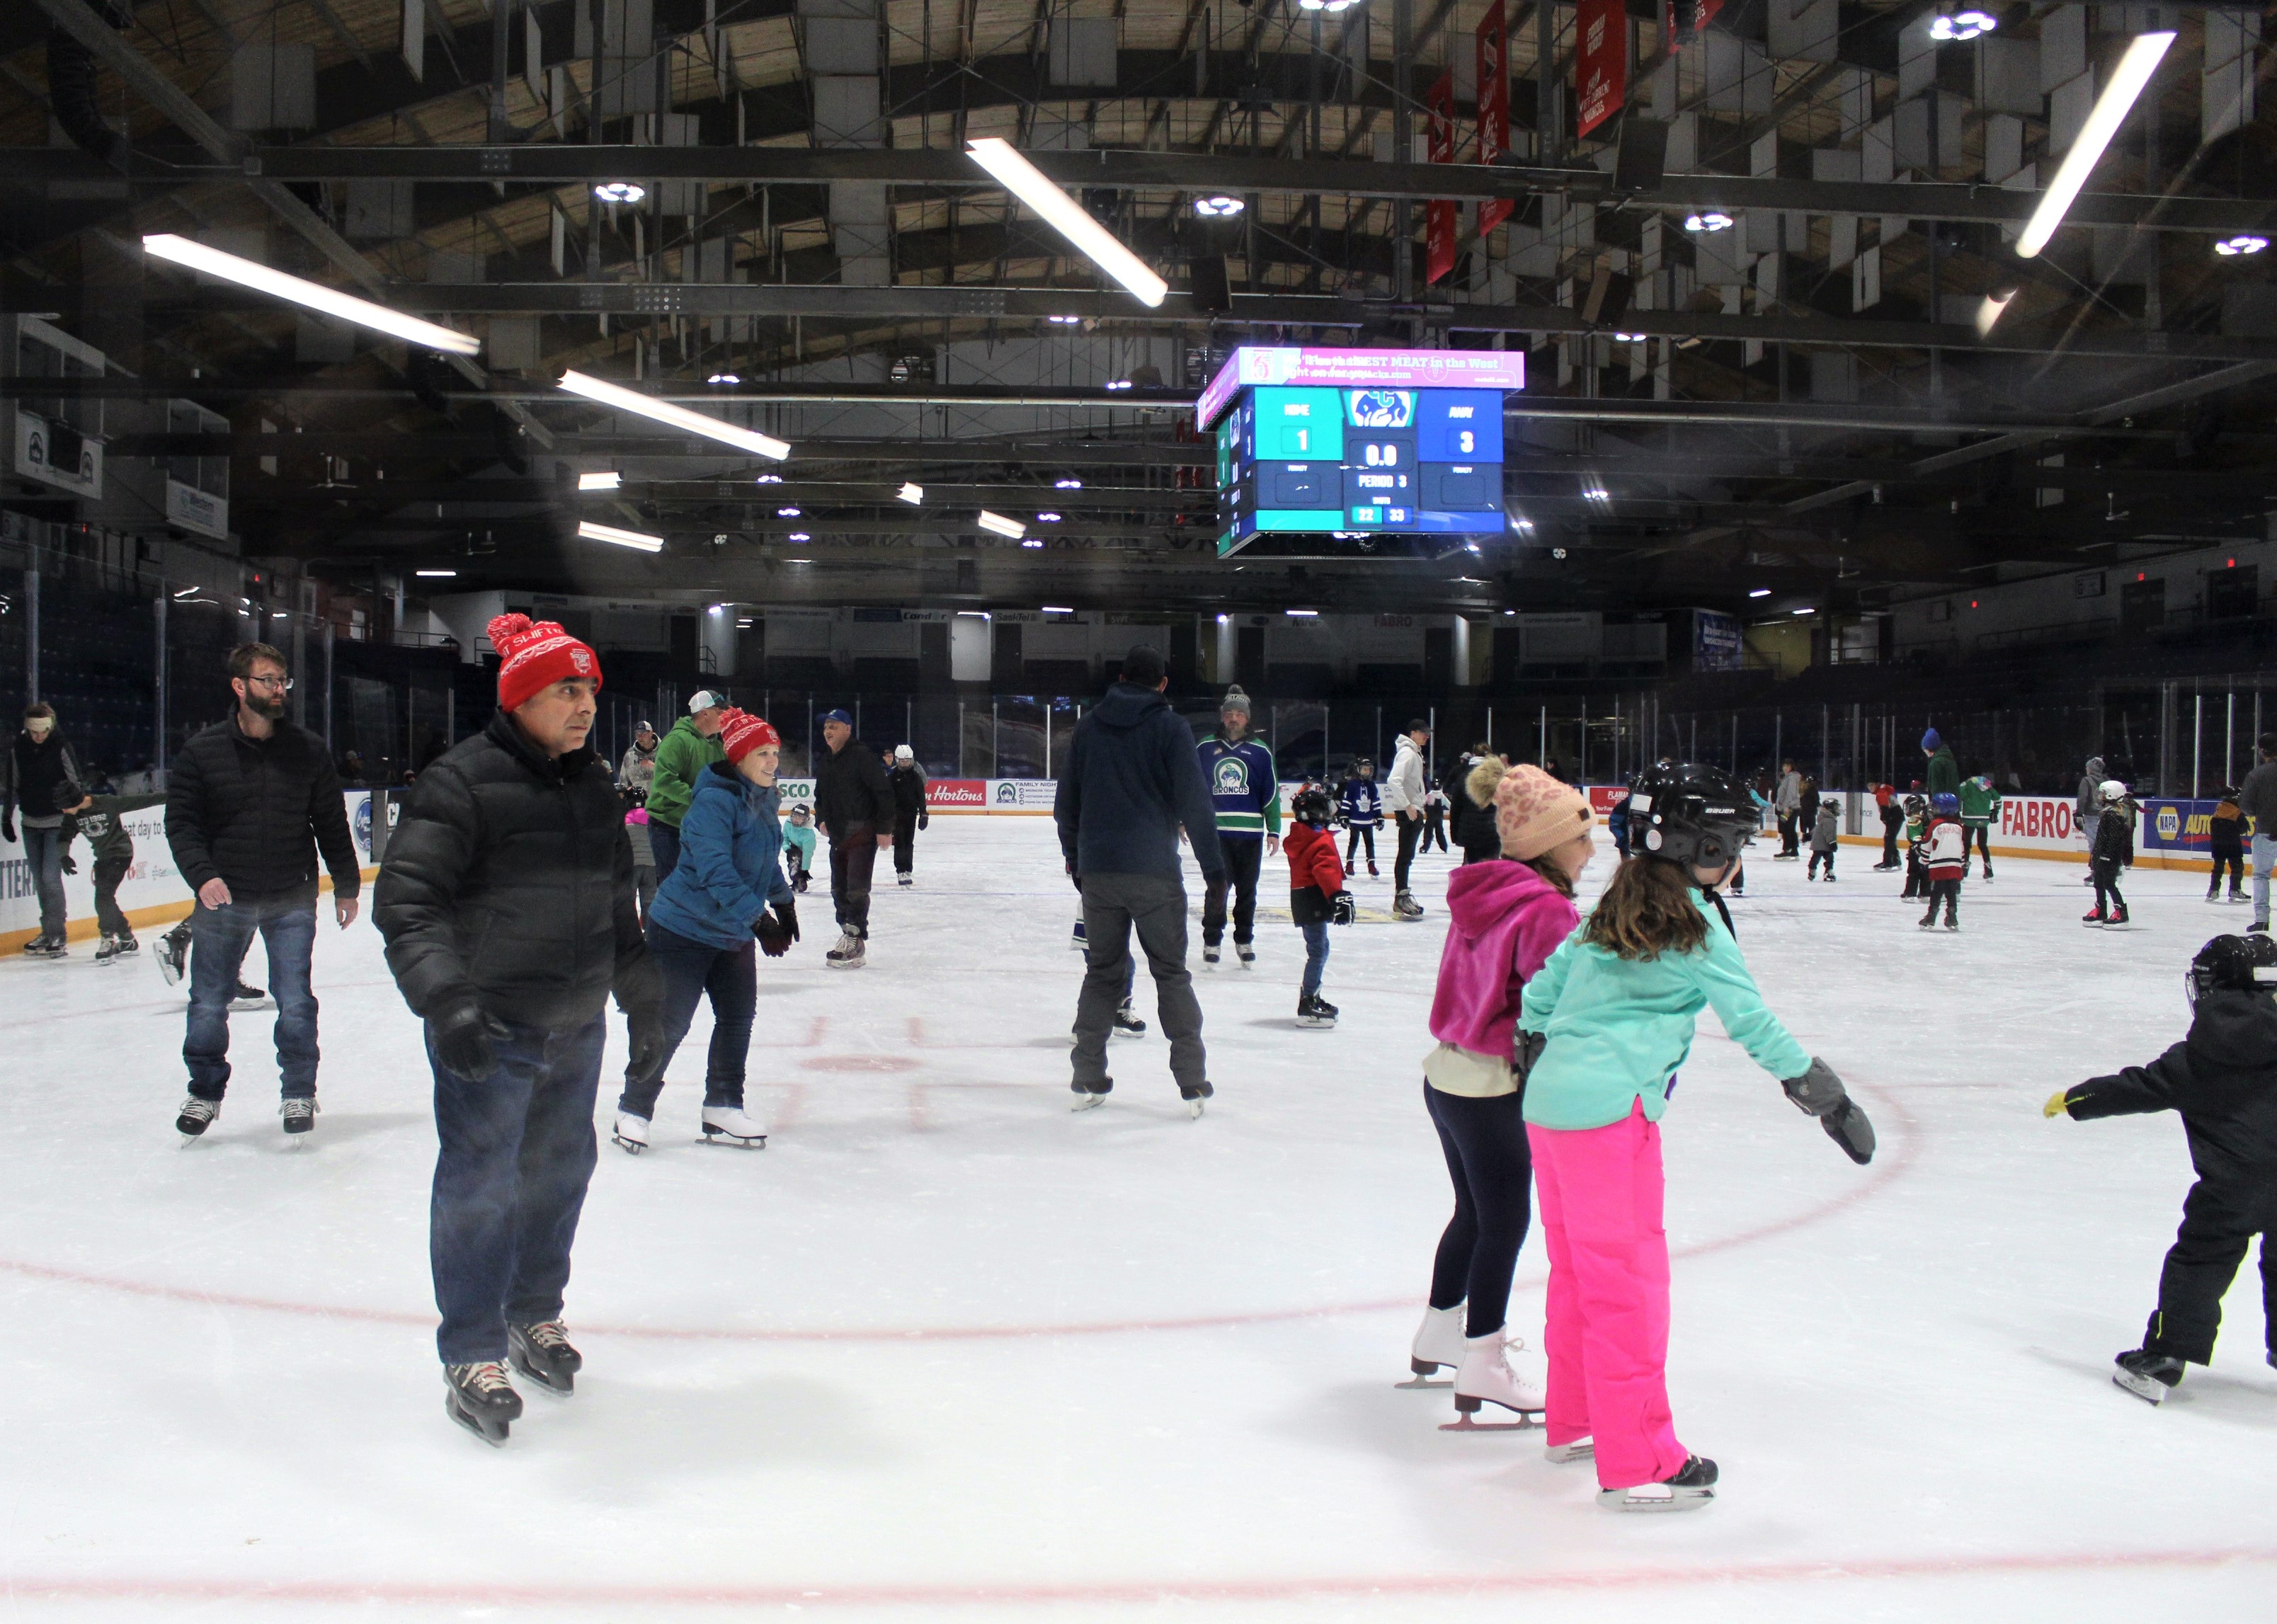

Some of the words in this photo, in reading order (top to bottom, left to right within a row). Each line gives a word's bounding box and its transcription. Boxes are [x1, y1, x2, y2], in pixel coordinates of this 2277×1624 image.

[1391, 357, 1428, 367] MEAT
[1430, 357, 1443, 367] in
[1446, 358, 1466, 367] the
[1468, 358, 1499, 369] West
[1284, 404, 1311, 416] HOME
[1449, 406, 1474, 418] AWAY
[1298, 429, 1308, 451] 1
[1460, 431, 1474, 453] 3
[1366, 445, 1397, 467] 0.0
[1359, 475, 1393, 488] PERIOD
[1399, 475, 1407, 488] 3
[1358, 508, 1374, 521] 22
[1390, 508, 1405, 522] 33
[513, 627, 552, 647] SWIFT
[934, 785, 983, 801] Hortons
[1213, 786, 1248, 794] BRONCOS
[2002, 801, 2070, 839] FABRO
[2159, 816, 2176, 831] NAPA
[138, 820, 152, 840] day
[154, 822, 161, 835] to
